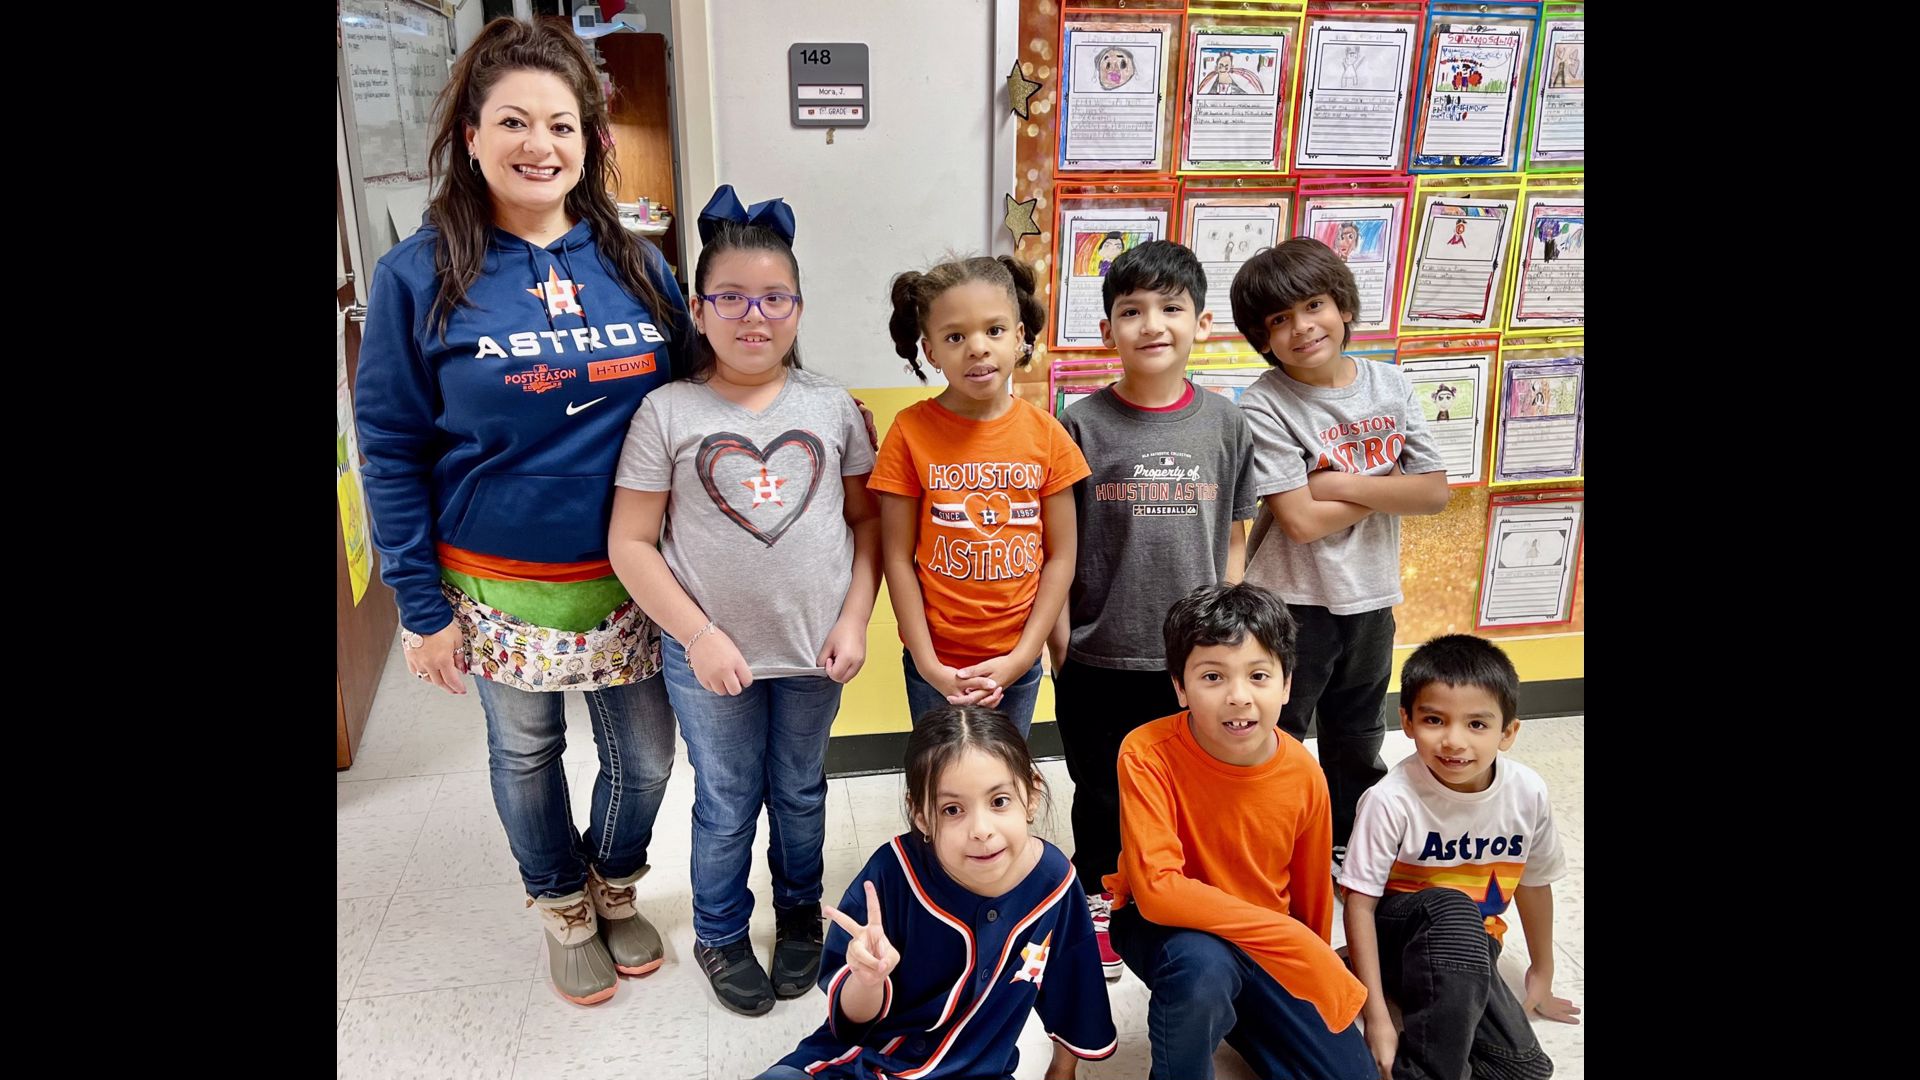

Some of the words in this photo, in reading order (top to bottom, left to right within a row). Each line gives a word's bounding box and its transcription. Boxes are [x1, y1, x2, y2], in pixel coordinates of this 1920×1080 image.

[800, 49, 831, 65] 148
[819, 88, 838, 96] Mora,
[839, 87, 846, 95] J.
[537, 279, 583, 317] H
[474, 322, 665, 359] ASTROS
[504, 368, 577, 385] POSTSEASON
[596, 359, 650, 376] H-TOWN
[1319, 415, 1397, 446] HOUSTON
[928, 463, 1042, 491] HOUSTON
[1133, 464, 1186, 481] Property
[1187, 465, 1201, 481] of
[750, 475, 782, 503] H
[1095, 482, 1170, 501] HOUSTON
[938, 511, 960, 521] SINCE
[1016, 508, 1035, 518] 1962
[980, 509, 998, 526] H
[1146, 506, 1185, 514] BASEBALL
[928, 533, 1038, 581] ASTROS
[1417, 831, 1524, 861] Astros
